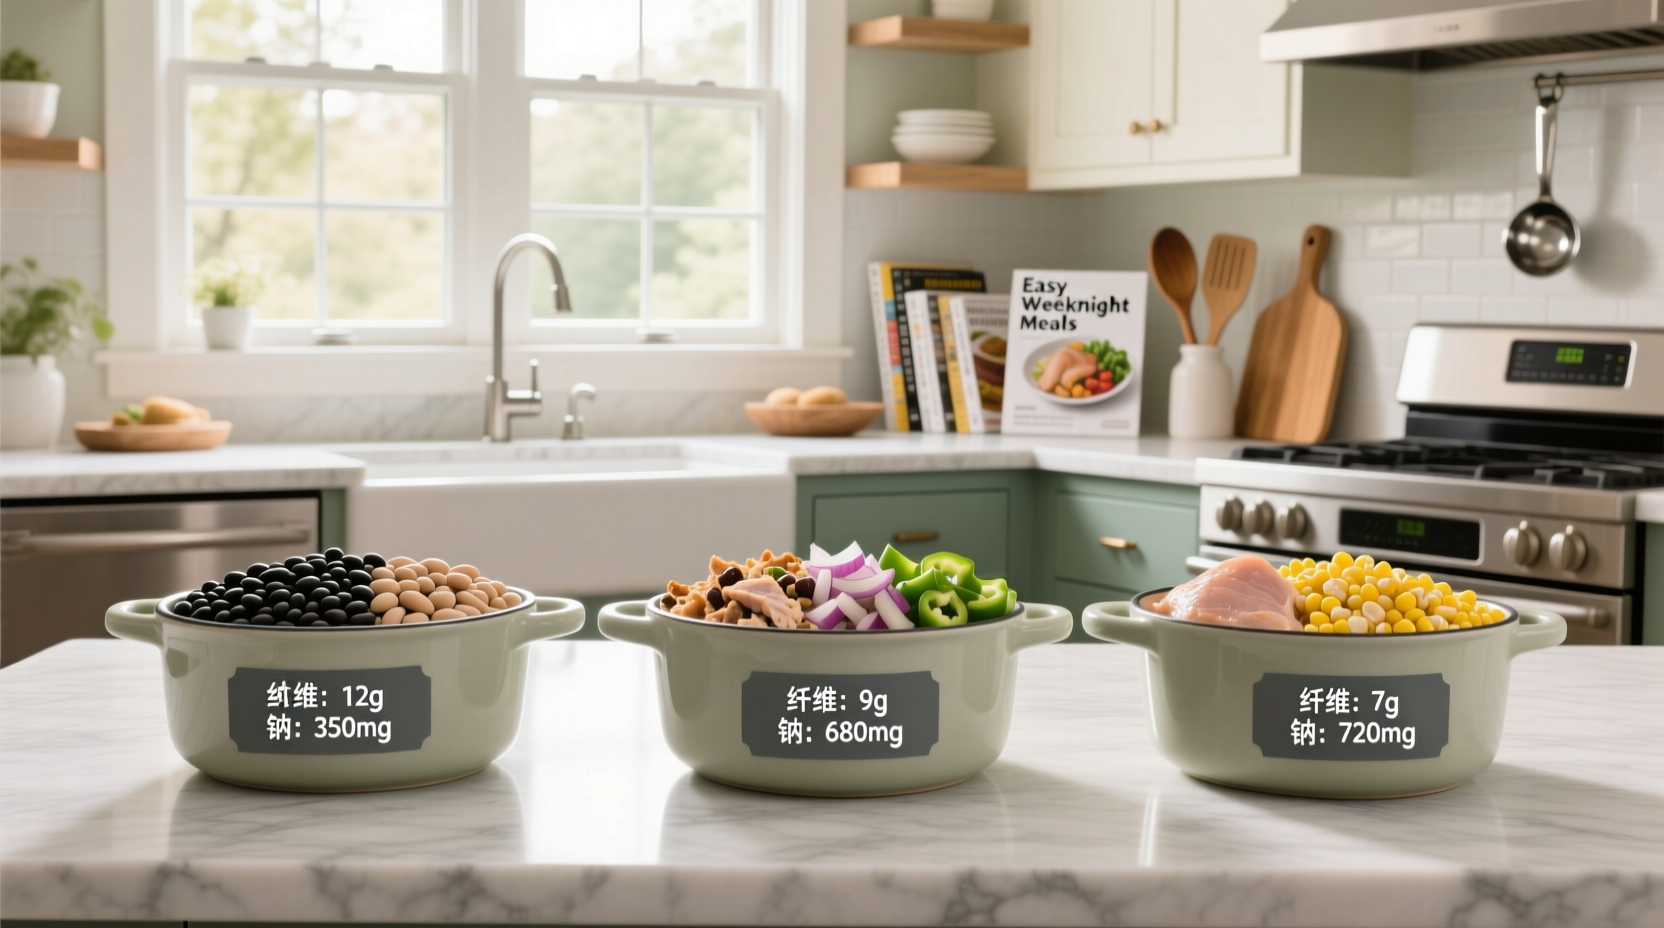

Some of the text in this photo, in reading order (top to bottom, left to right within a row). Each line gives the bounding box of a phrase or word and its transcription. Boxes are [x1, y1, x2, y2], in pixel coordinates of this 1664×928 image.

[1022, 276, 1068, 297] Easy
[1021, 296, 1130, 317] Weeknight
[1020, 315, 1077, 331] Meals
